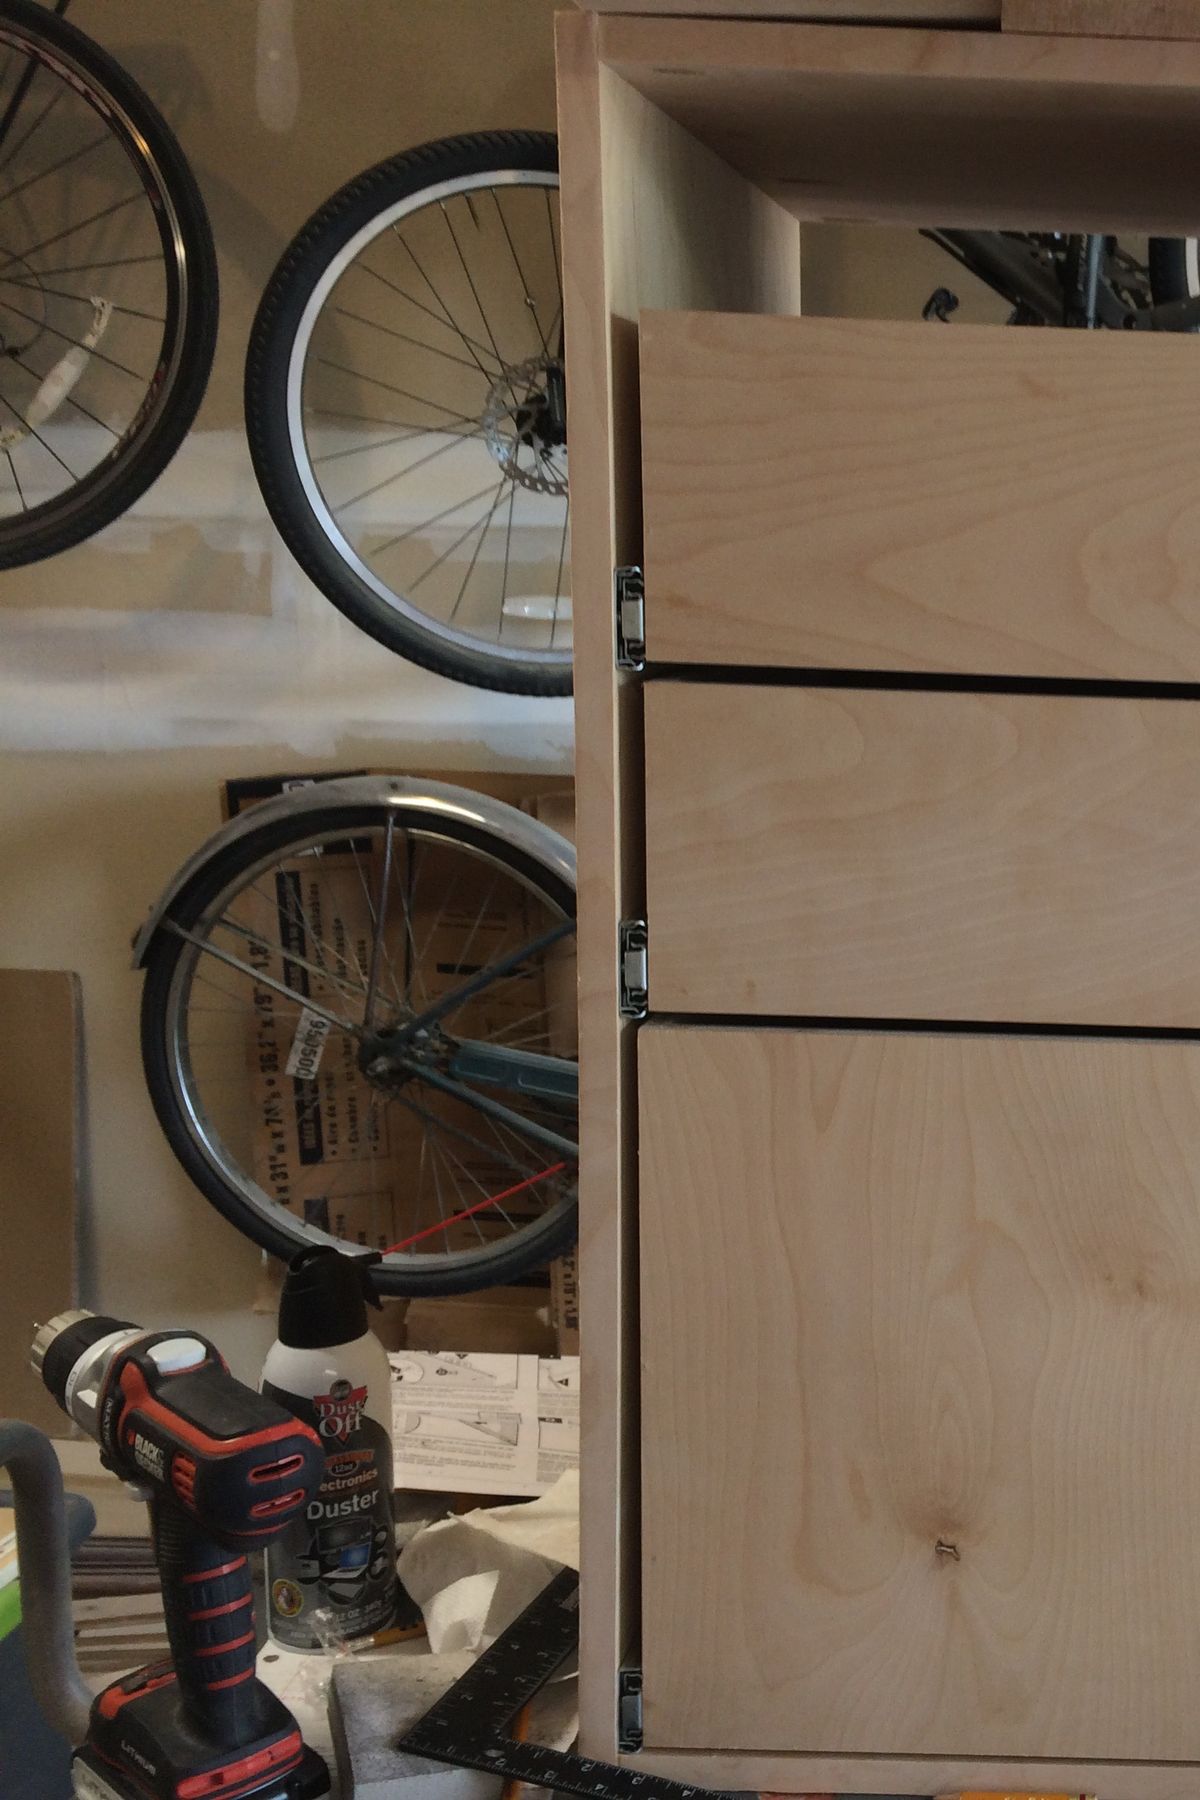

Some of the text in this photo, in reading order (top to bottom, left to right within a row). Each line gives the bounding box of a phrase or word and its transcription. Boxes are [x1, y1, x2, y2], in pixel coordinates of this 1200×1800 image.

[318, 1413, 364, 1438] Off
[318, 1467, 379, 1493] ectronics
[306, 1488, 379, 1521] Duster
